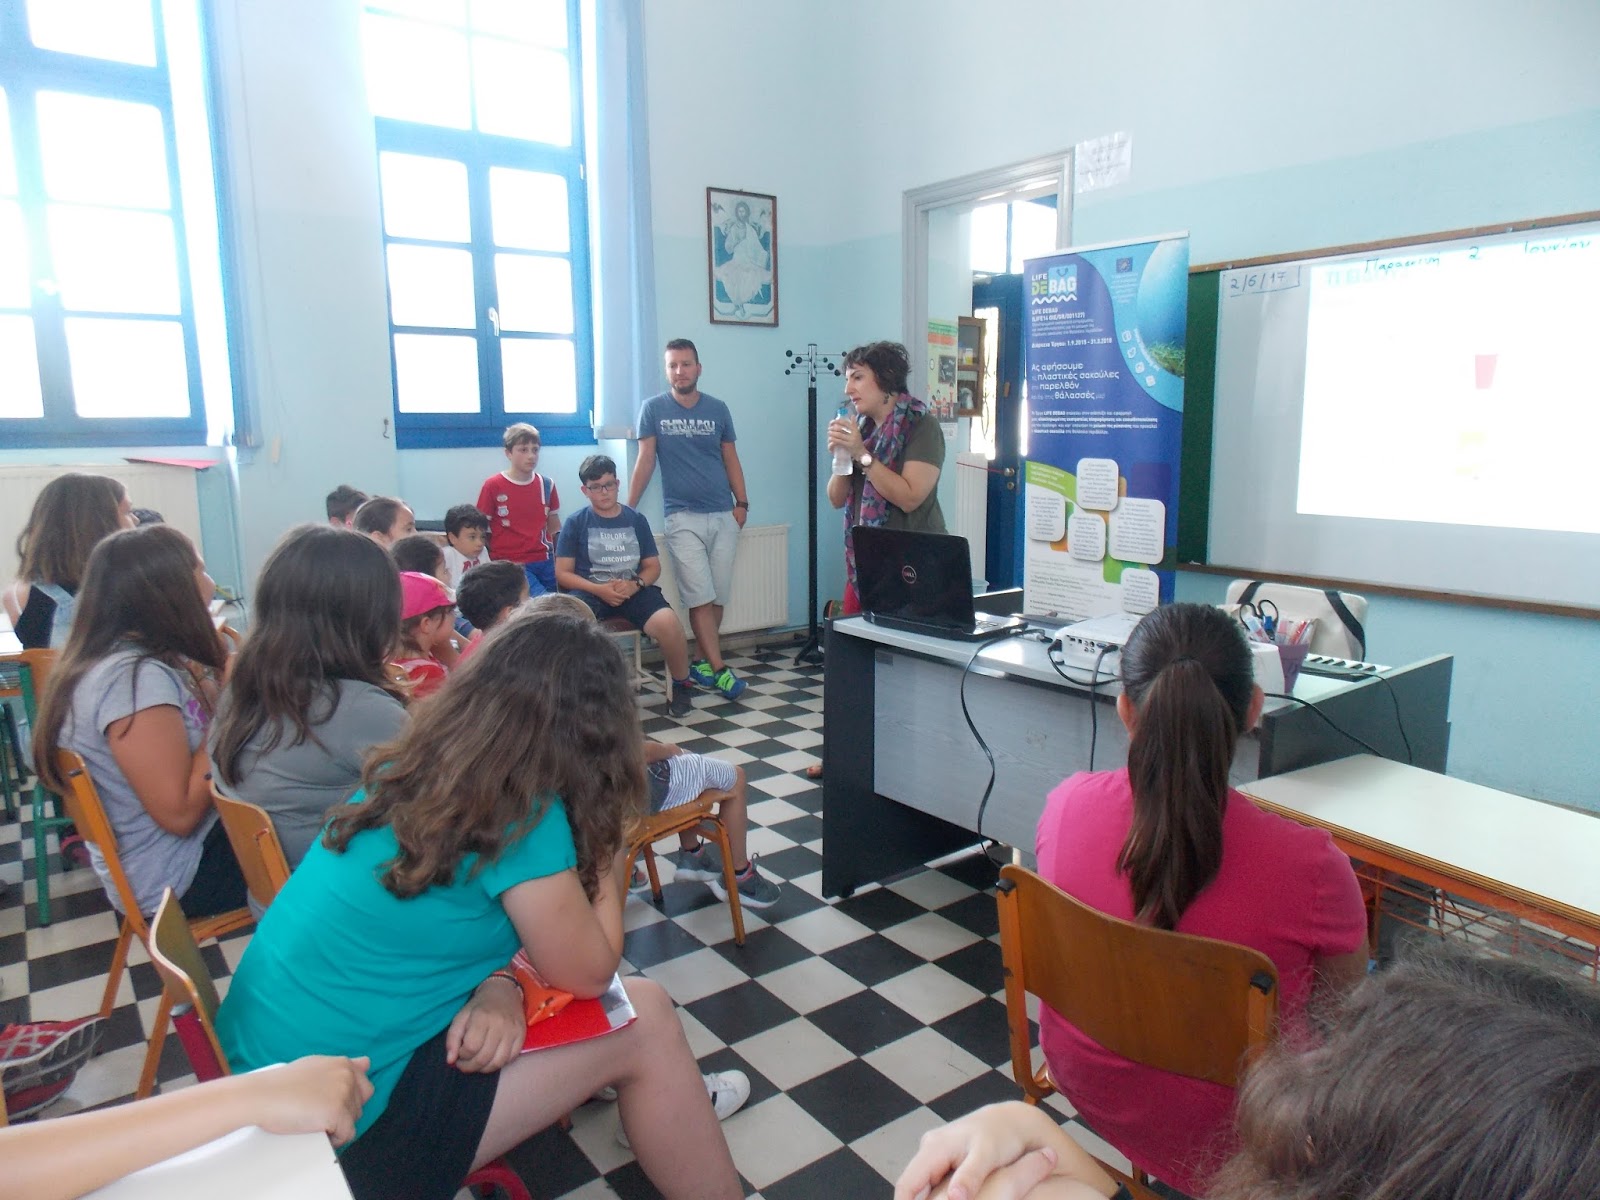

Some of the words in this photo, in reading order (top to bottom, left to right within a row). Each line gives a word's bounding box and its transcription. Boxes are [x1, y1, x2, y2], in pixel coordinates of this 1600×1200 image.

[1468, 246, 1480, 260] 2
[1031, 273, 1048, 281] LIFE
[1230, 271, 1287, 292] 2/6/17
[1031, 363, 1040, 372] Ας
[1041, 361, 1084, 372] αφήσουμε
[1037, 371, 1078, 381] πλαστικές
[1080, 370, 1120, 380] σακούλες
[1039, 381, 1080, 391] παρελθόν
[1055, 391, 1095, 401] θάλασσές
[600, 532, 626, 540] EXPLORE
